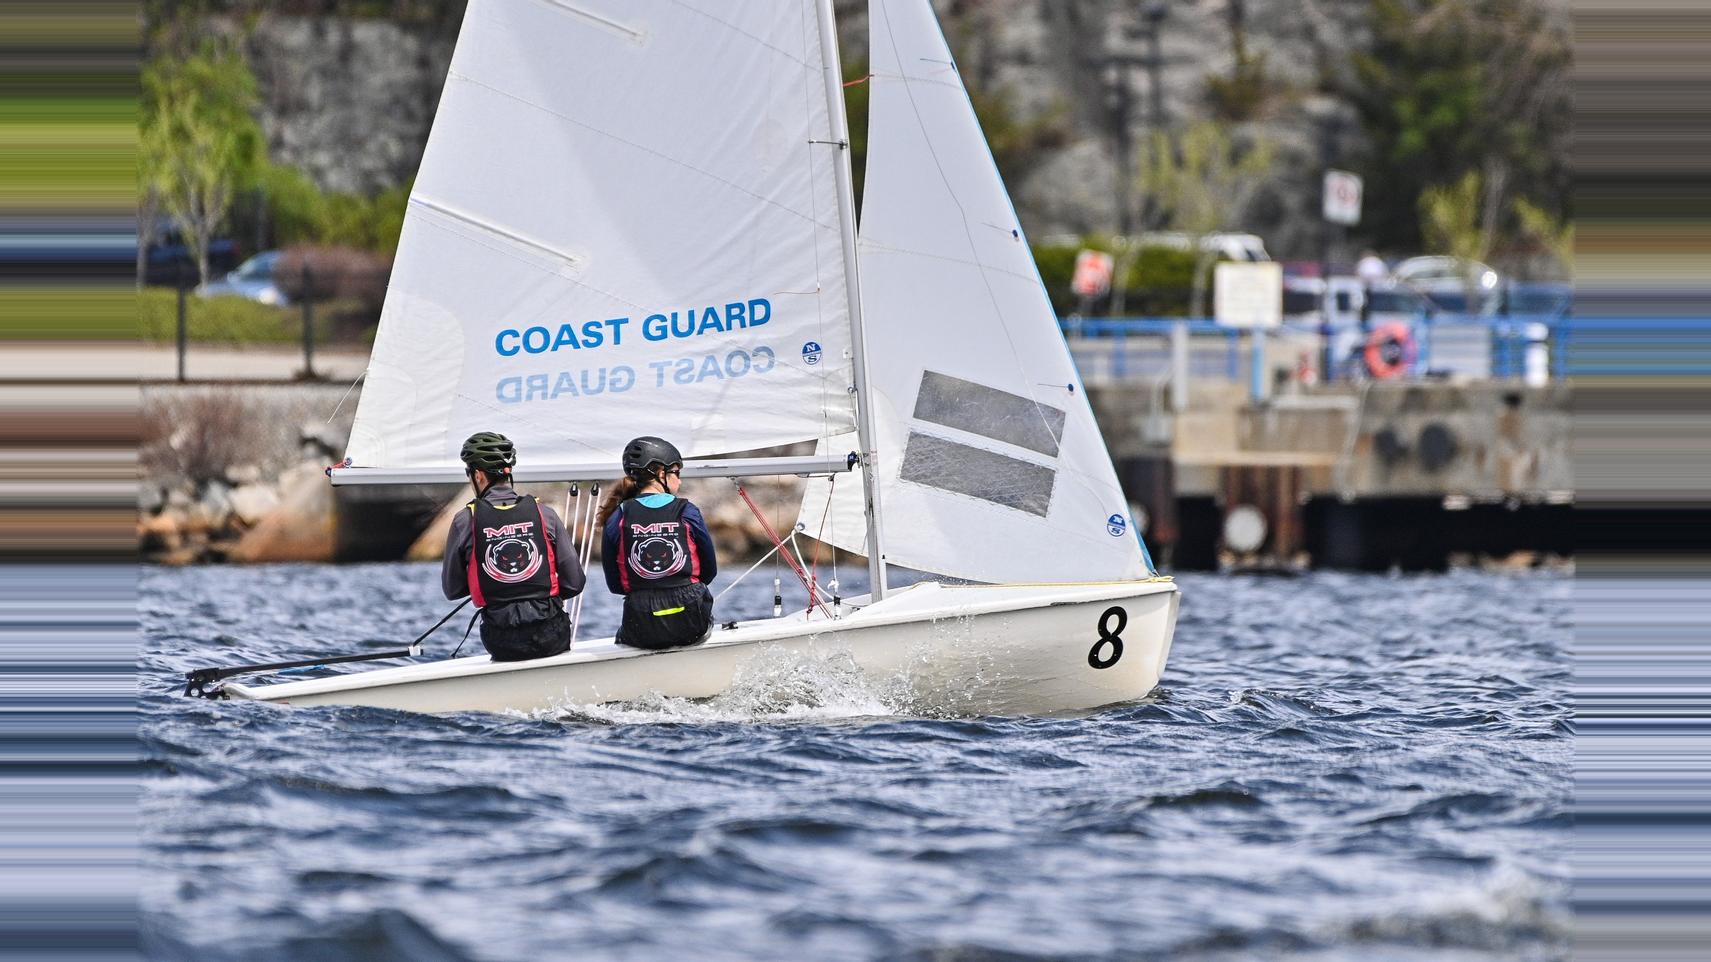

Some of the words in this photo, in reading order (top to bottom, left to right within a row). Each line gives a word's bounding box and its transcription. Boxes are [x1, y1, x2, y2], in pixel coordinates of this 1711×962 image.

[495, 317, 629, 357] COAST
[642, 298, 771, 341] GUARD
[483, 521, 534, 538] MIT
[631, 522, 680, 534] MIT
[1087, 606, 1128, 670] 8
